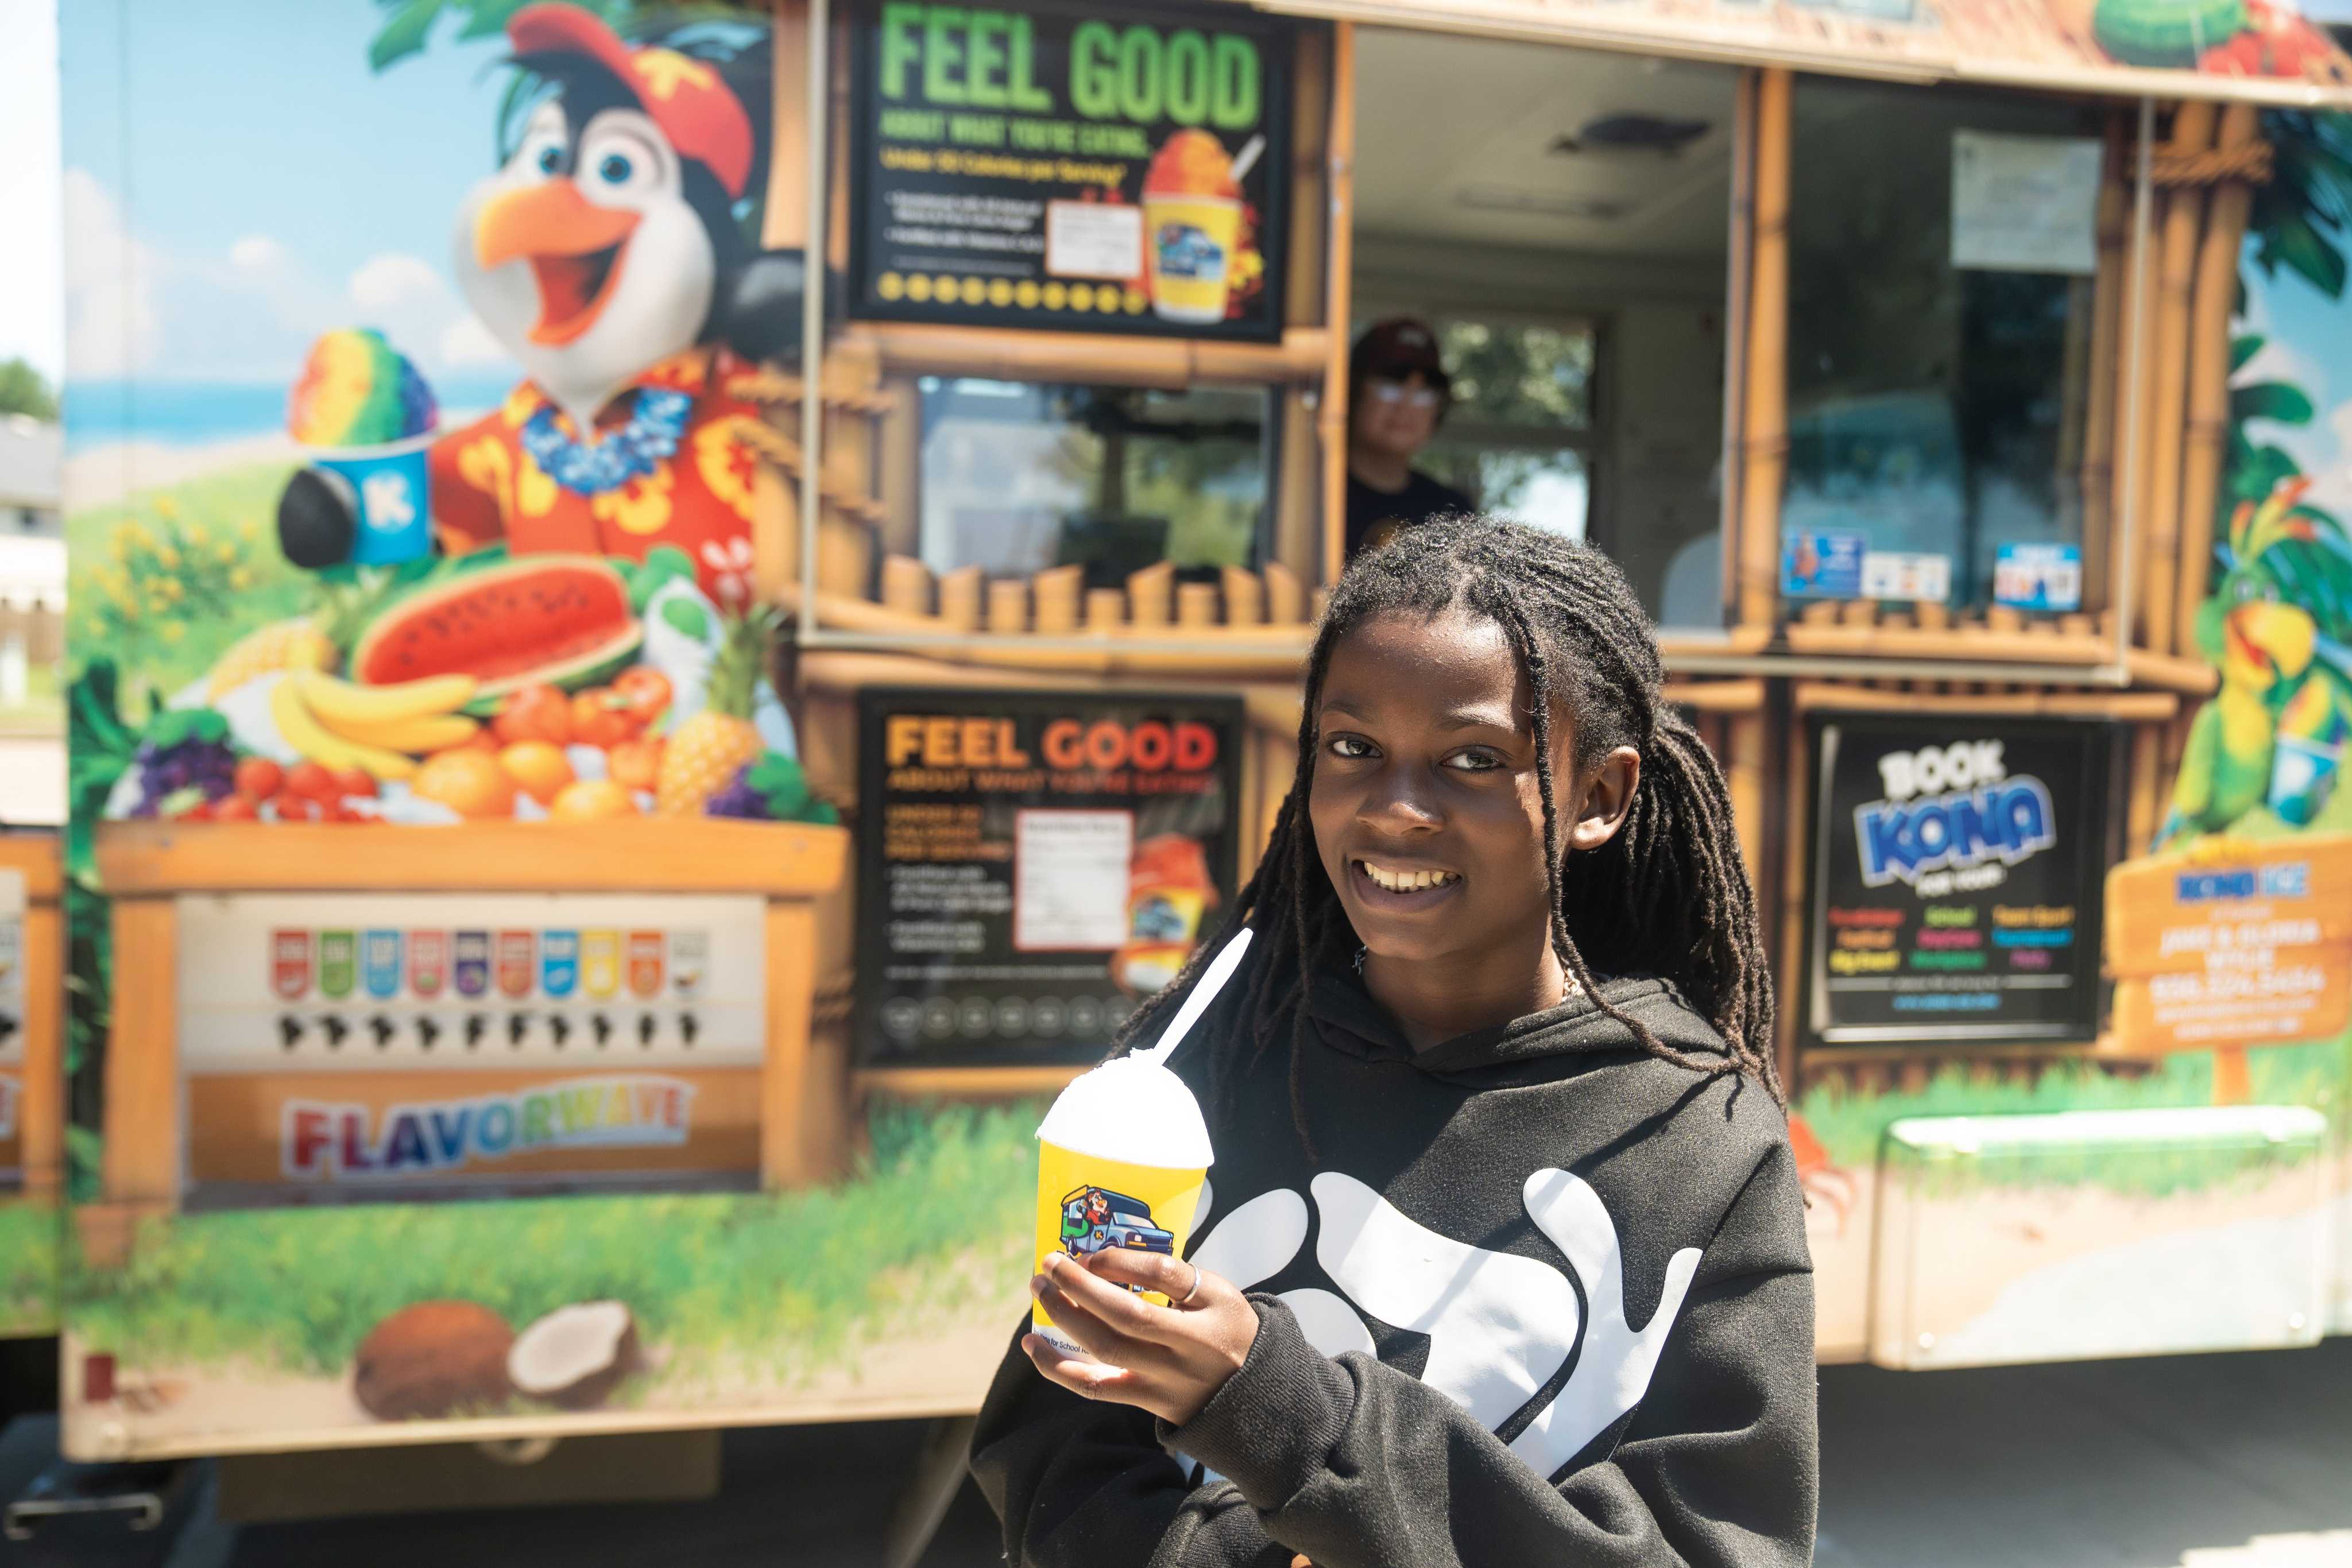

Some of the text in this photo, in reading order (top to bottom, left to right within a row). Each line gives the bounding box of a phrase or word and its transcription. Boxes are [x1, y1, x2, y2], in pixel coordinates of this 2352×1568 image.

[879, 3, 1259, 129] FEEL GOOD
[879, 109, 945, 144] ABOUT
[949, 113, 1004, 148] WHAT
[1009, 118, 1076, 153] YOU'RE
[880, 149, 933, 171] Under
[963, 154, 1027, 178] Calories
[1030, 161, 1055, 184] per
[363, 471, 415, 529] K
[885, 714, 1217, 771] FEEL GOOD
[887, 769, 970, 792] ABOUT
[976, 771, 1046, 792] WHAT
[1051, 771, 1129, 794] YOU'RE
[1879, 739, 2006, 799] BOOK
[1856, 775, 2055, 885] KONA
[2177, 863, 2309, 903] KONA ICE
[1925, 905, 1976, 926] School
[286, 1077, 690, 1177] FLAVORWAVE
[1051, 1338, 1059, 1346] for
[1059, 1341, 1081, 1353] School
